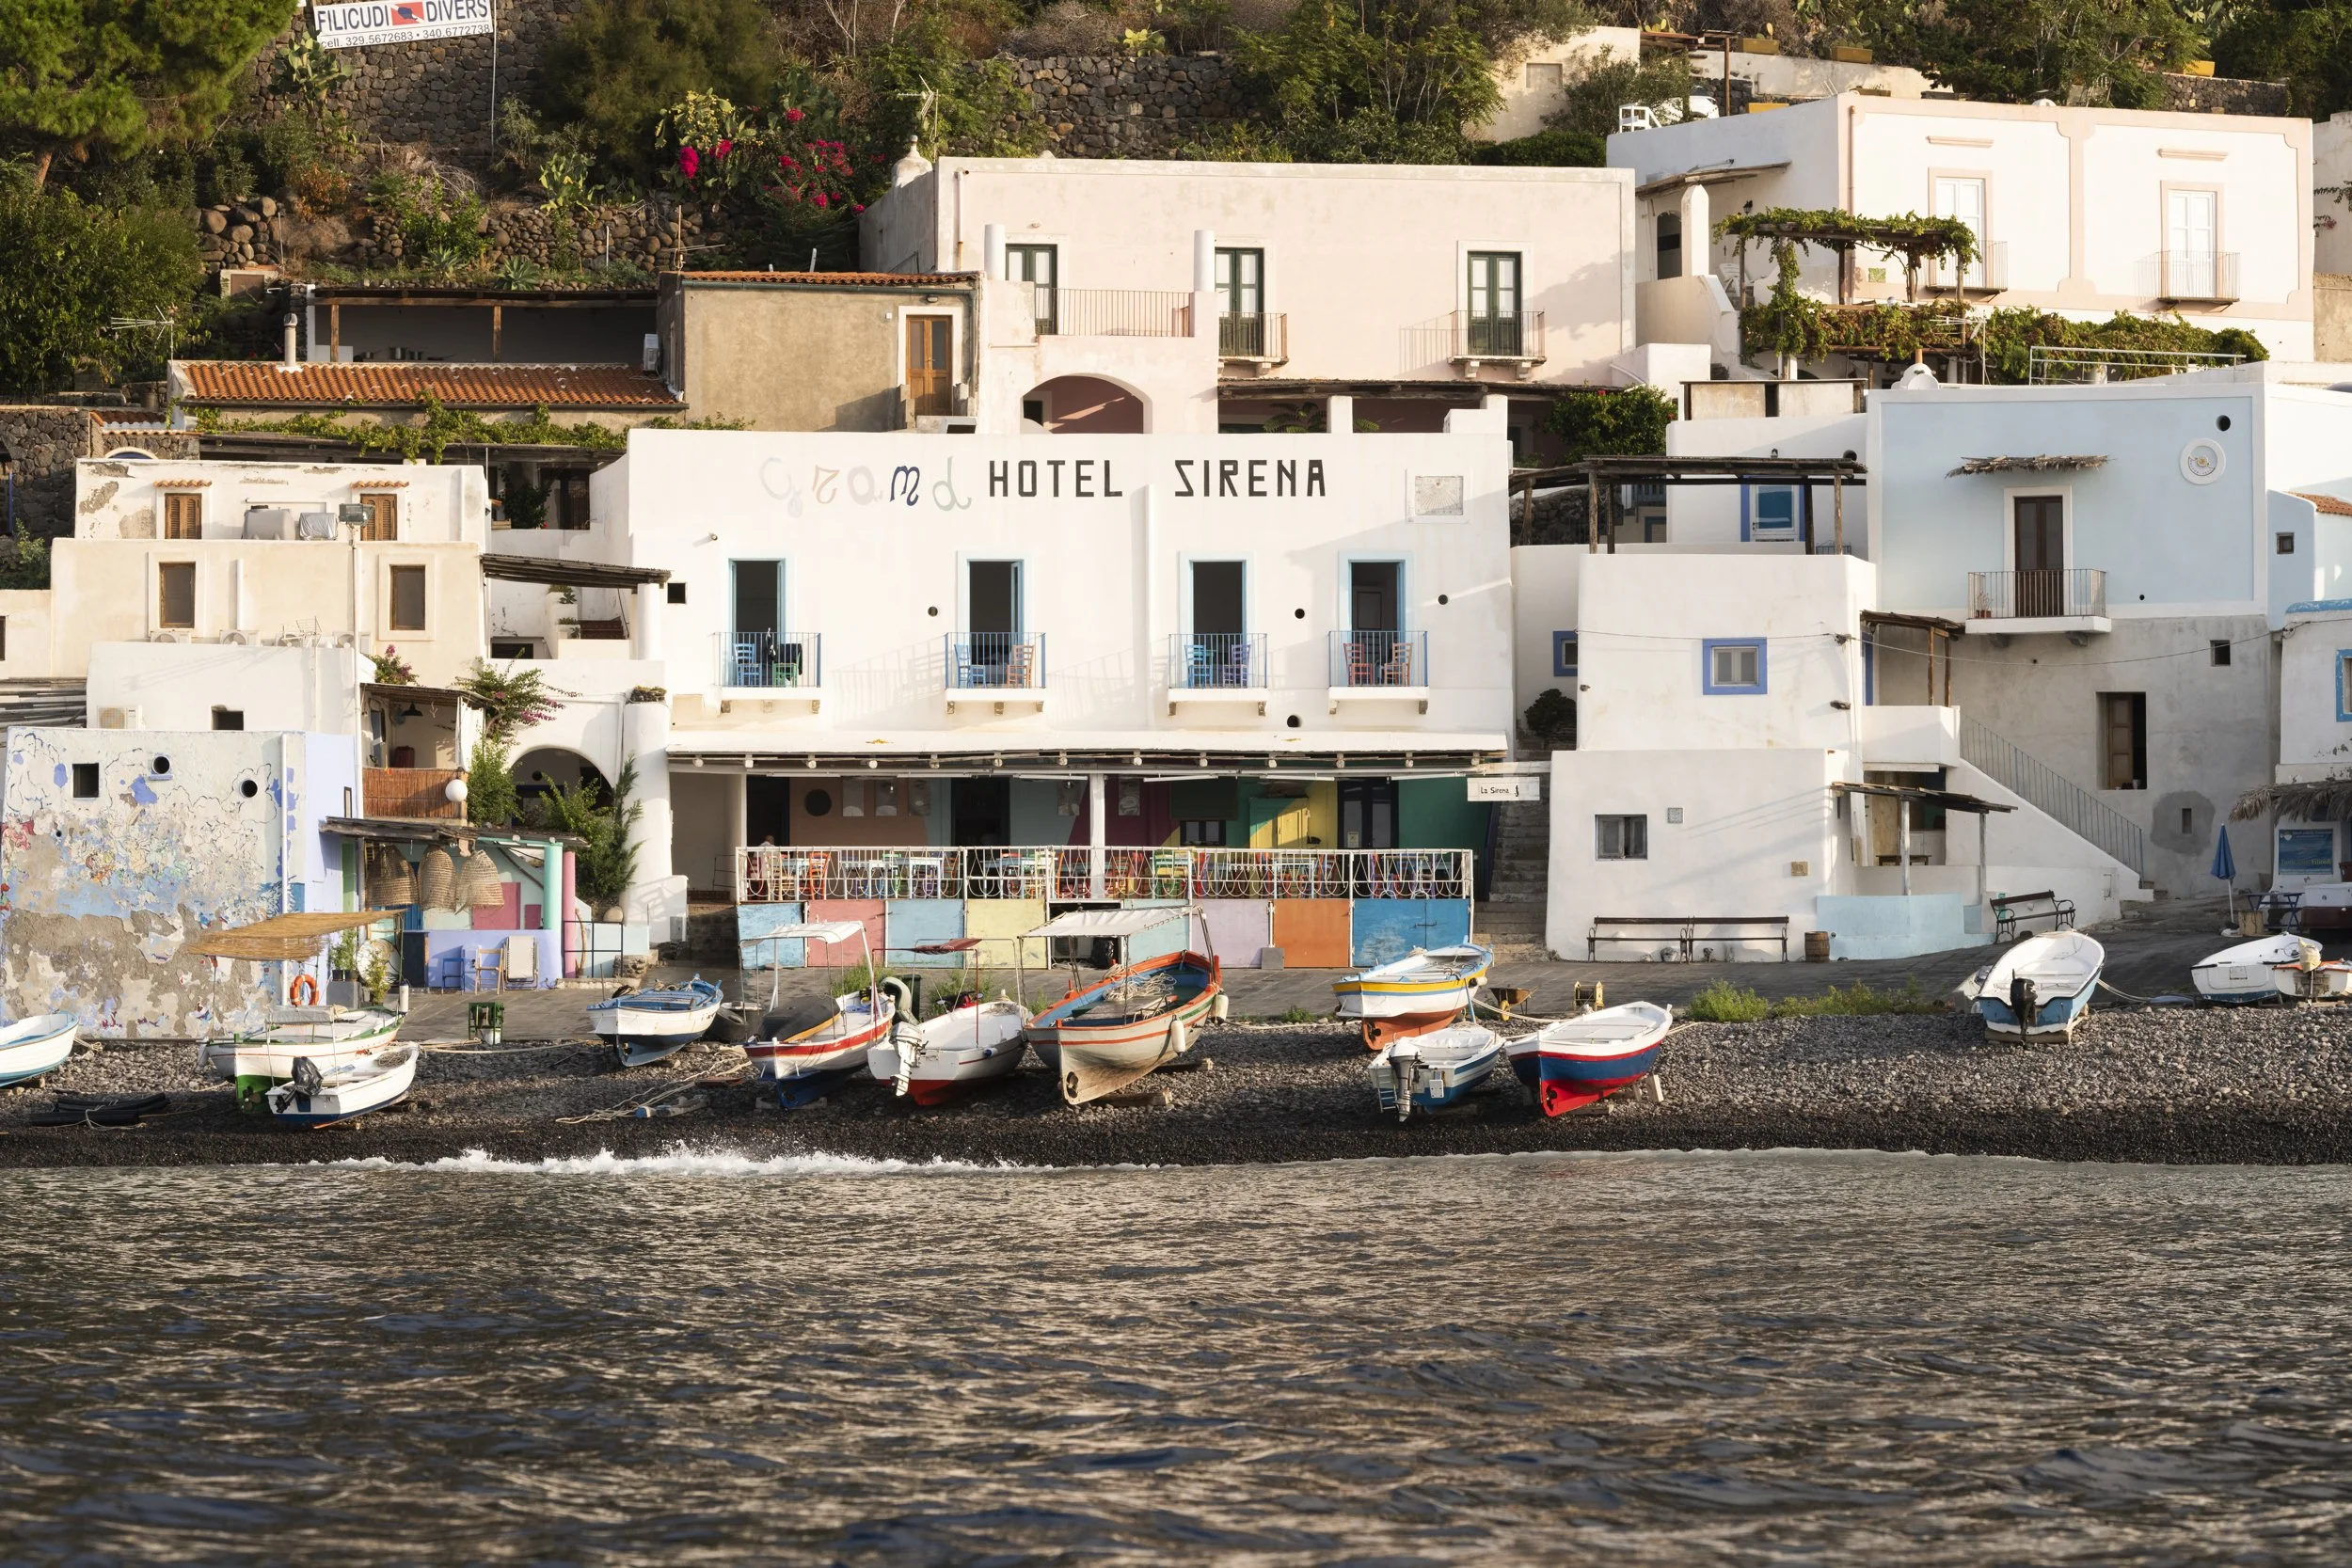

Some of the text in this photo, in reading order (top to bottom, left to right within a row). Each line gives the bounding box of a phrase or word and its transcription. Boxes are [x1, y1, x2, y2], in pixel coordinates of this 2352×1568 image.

[318, 0, 488, 31] FILICUDI DIVERS
[321, 24, 490, 48] cell. 329.5672683 340.6772738
[989, 459, 1123, 498] HOTEL
[1174, 458, 1327, 498] SIRENA
